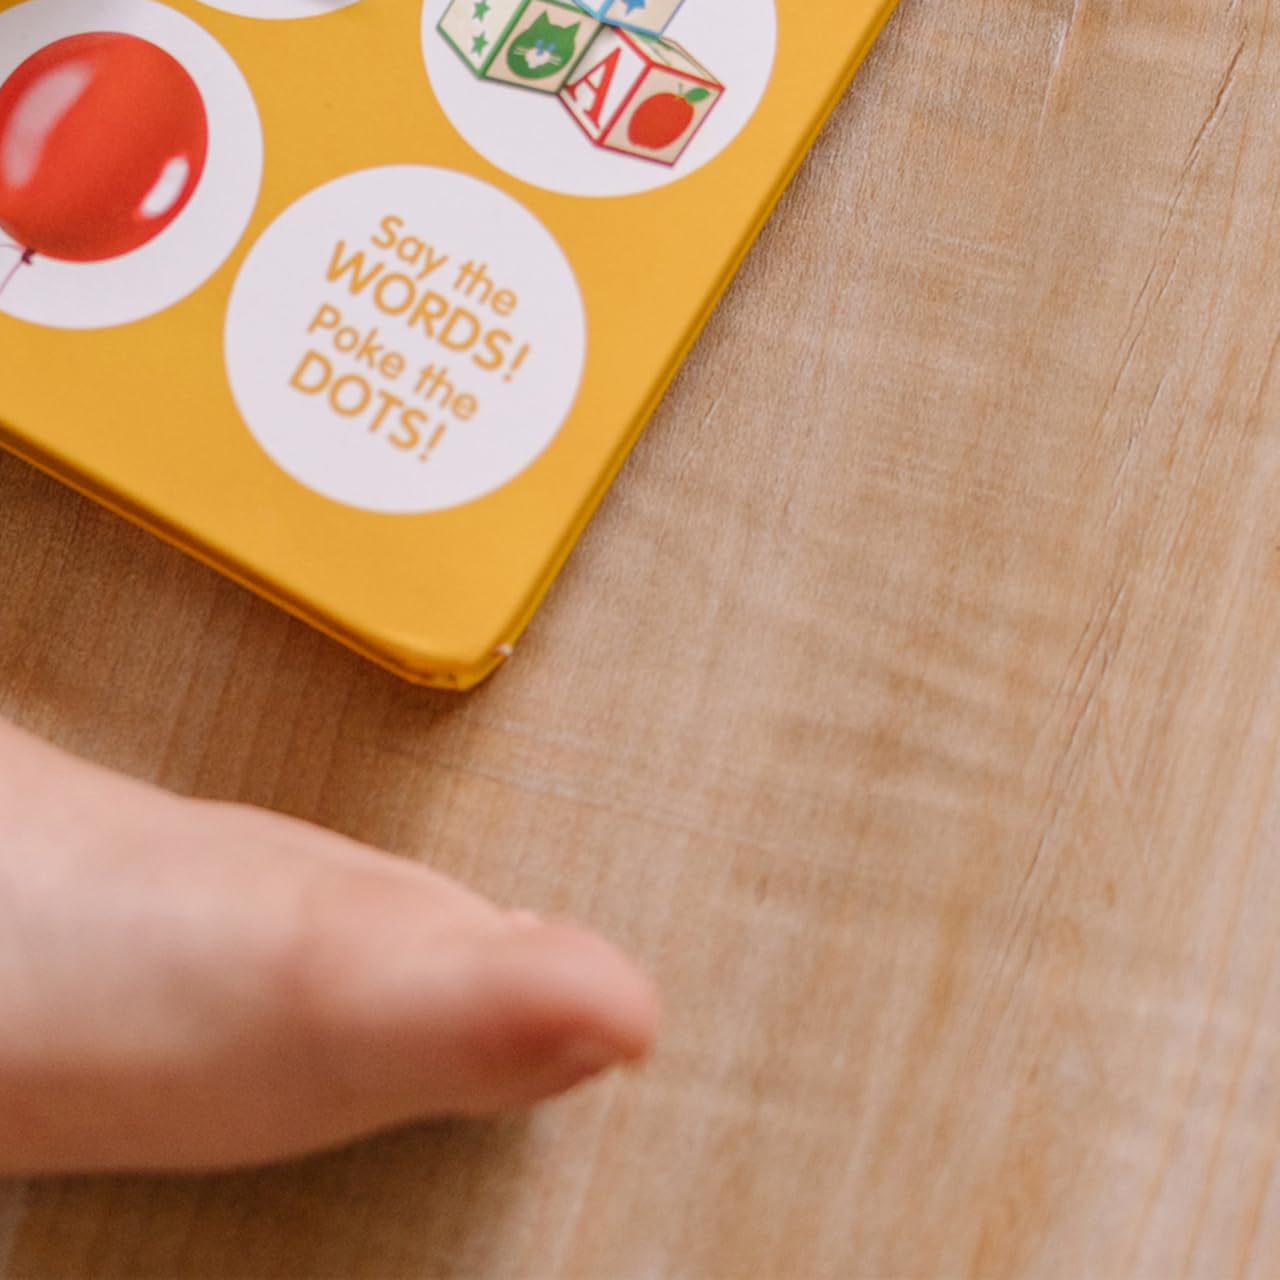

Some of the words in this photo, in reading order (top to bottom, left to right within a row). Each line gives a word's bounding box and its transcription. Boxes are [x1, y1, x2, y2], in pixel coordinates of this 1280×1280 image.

[566, 46, 622, 131] A
[326, 240, 531, 383] WORDS!
[371, 215, 448, 280] Say
[453, 260, 518, 316] the
[289, 349, 446, 463] DOTS!
[307, 303, 406, 380] Poke
[413, 364, 479, 422] the
